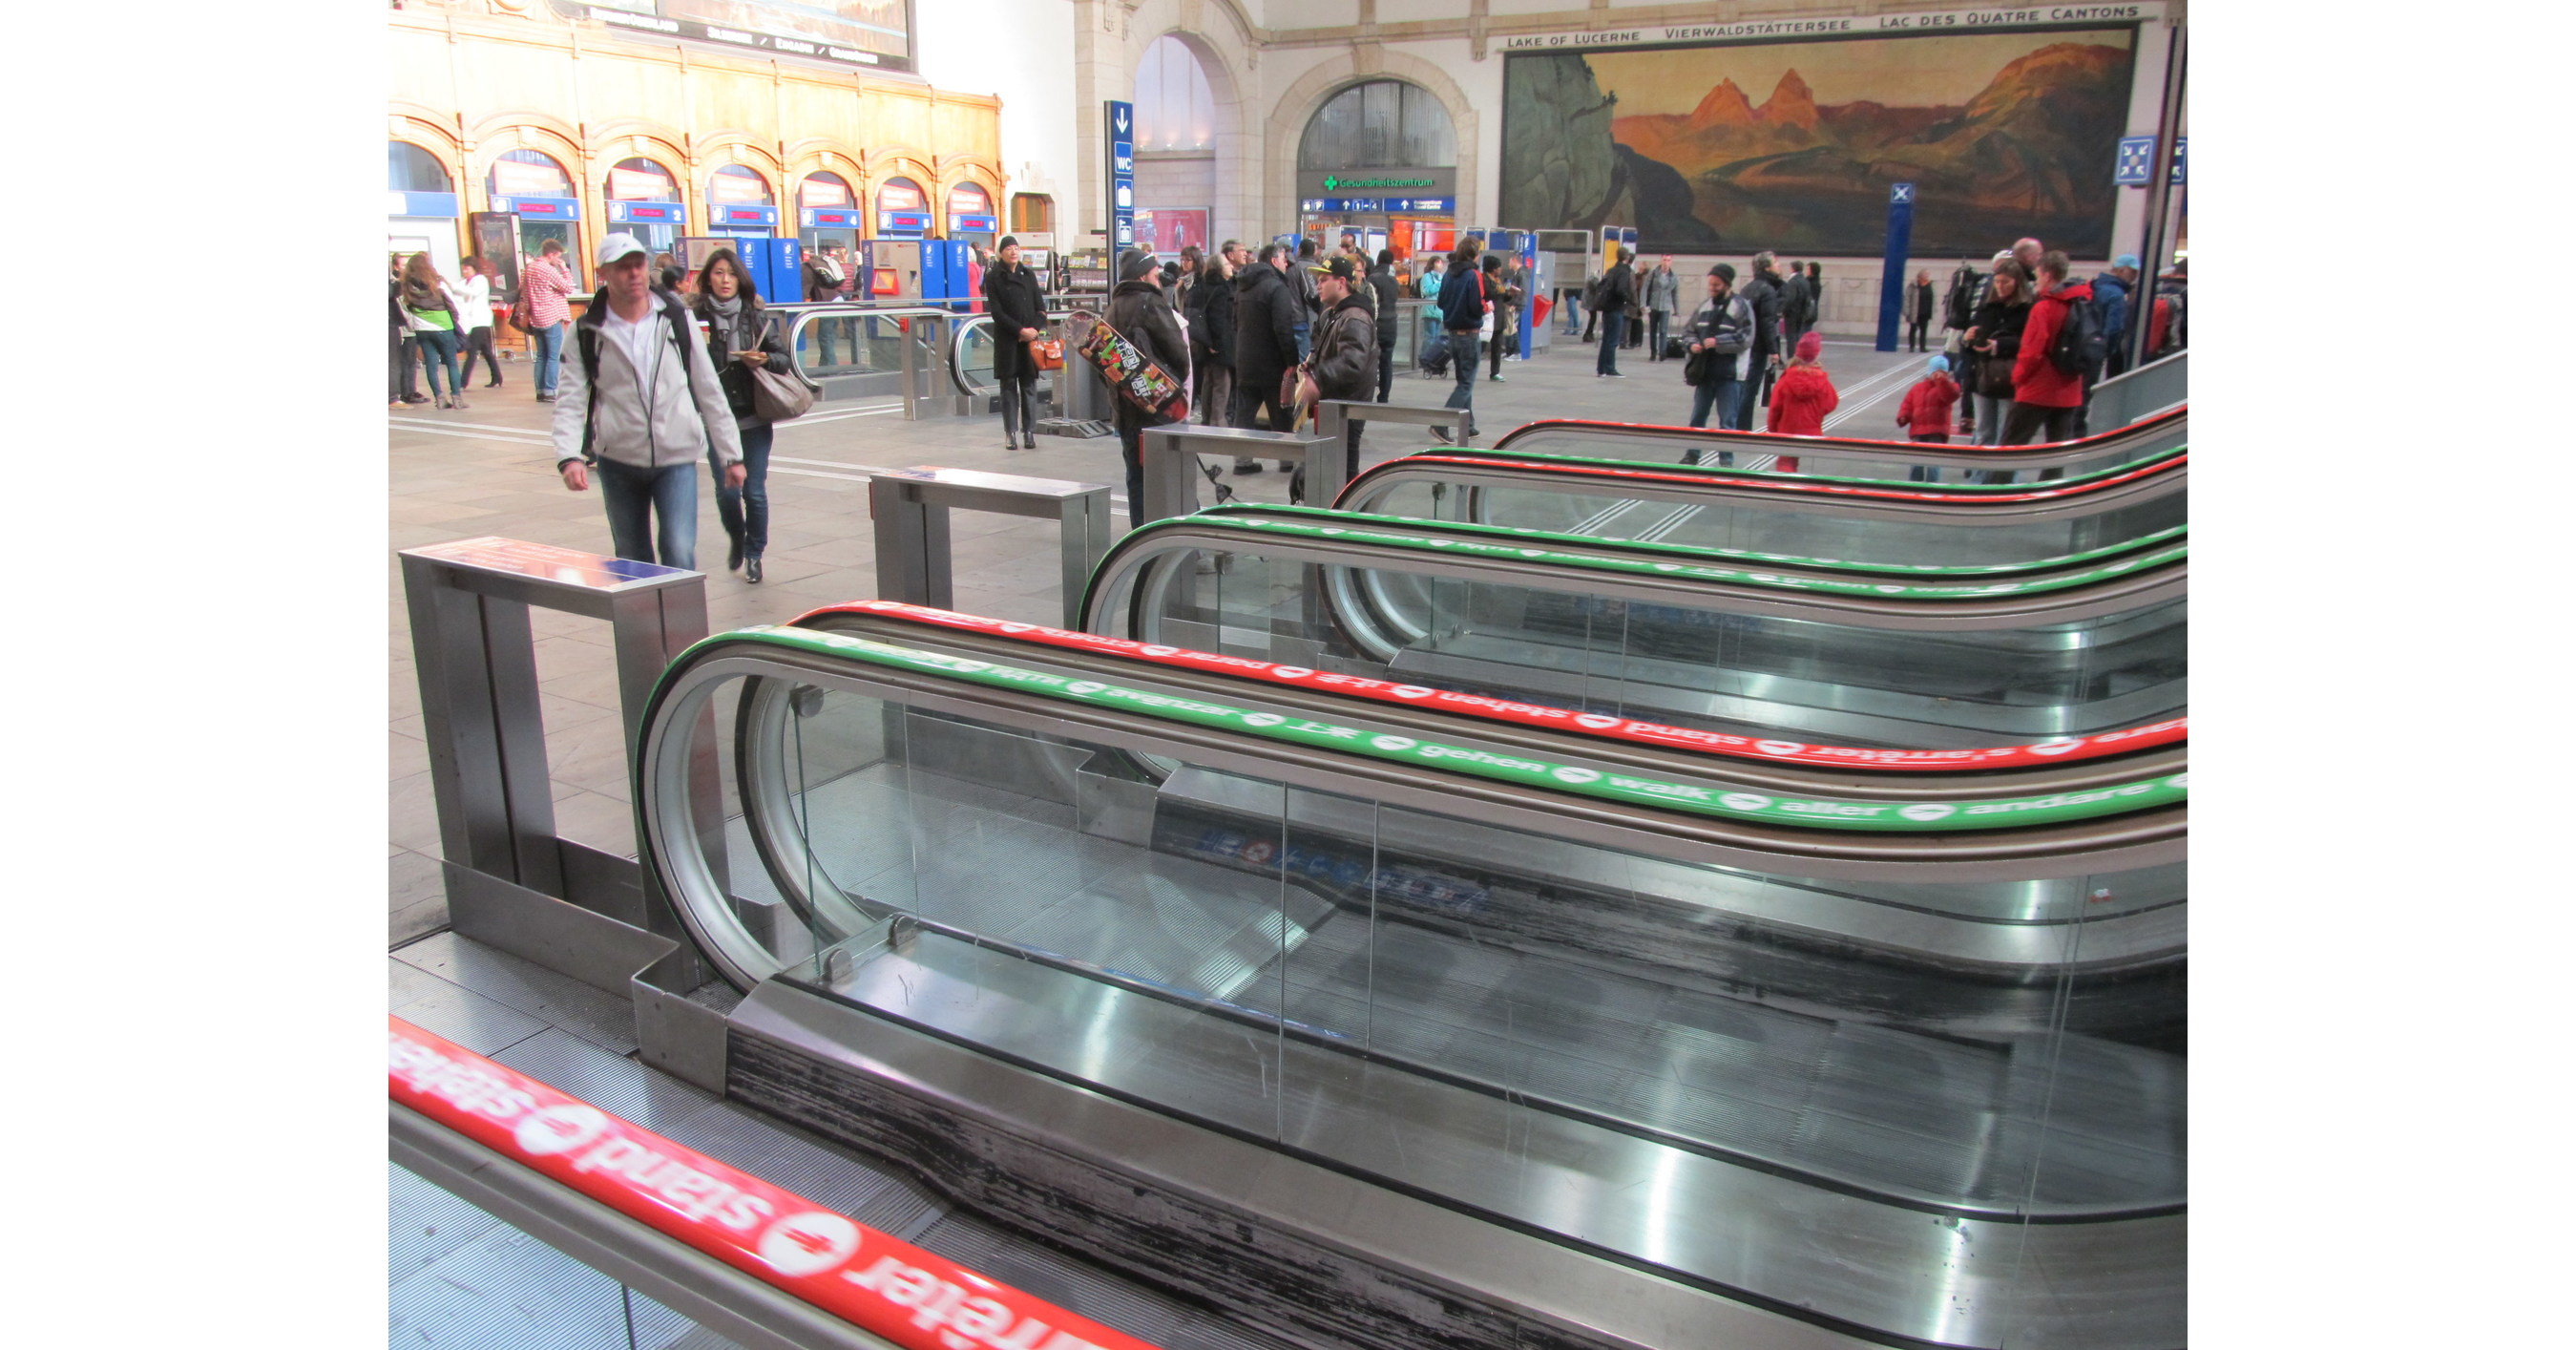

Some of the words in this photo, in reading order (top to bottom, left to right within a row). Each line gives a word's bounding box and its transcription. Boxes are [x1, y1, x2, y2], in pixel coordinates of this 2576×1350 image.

[1879, 16, 1911, 29] LAC
[1920, 14, 1955, 26] DES
[1967, 11, 2040, 24] QUATRE
[2051, 6, 2139, 21] CANTONS
[1665, 19, 1851, 39] VIERWALDSTÄTTERSEE
[1507, 35, 1542, 48] LAKE
[1550, 35, 1567, 47] OF
[1575, 31, 1641, 45] LUCERNE
[1117, 157, 1131, 170] WC
[1339, 177, 1434, 188] Gesundheitszentrum
[566, 205, 575, 217] 1
[673, 209, 681, 221] 2
[766, 212, 774, 222] 3
[849, 215, 857, 225] 4
[1183, 650, 1273, 670] parar
[1106, 689, 1239, 717] avanzar
[1437, 691, 1570, 719] stehen
[1624, 721, 1749, 746] stand
[1811, 746, 2018, 762] s'arrêter
[1418, 745, 1547, 772] gehen
[1610, 775, 1714, 801] walk
[1779, 799, 1892, 817] aller
[1964, 783, 2155, 816] andare
[388, 1031, 535, 1118] stehe
[570, 1135, 775, 1231] stand
